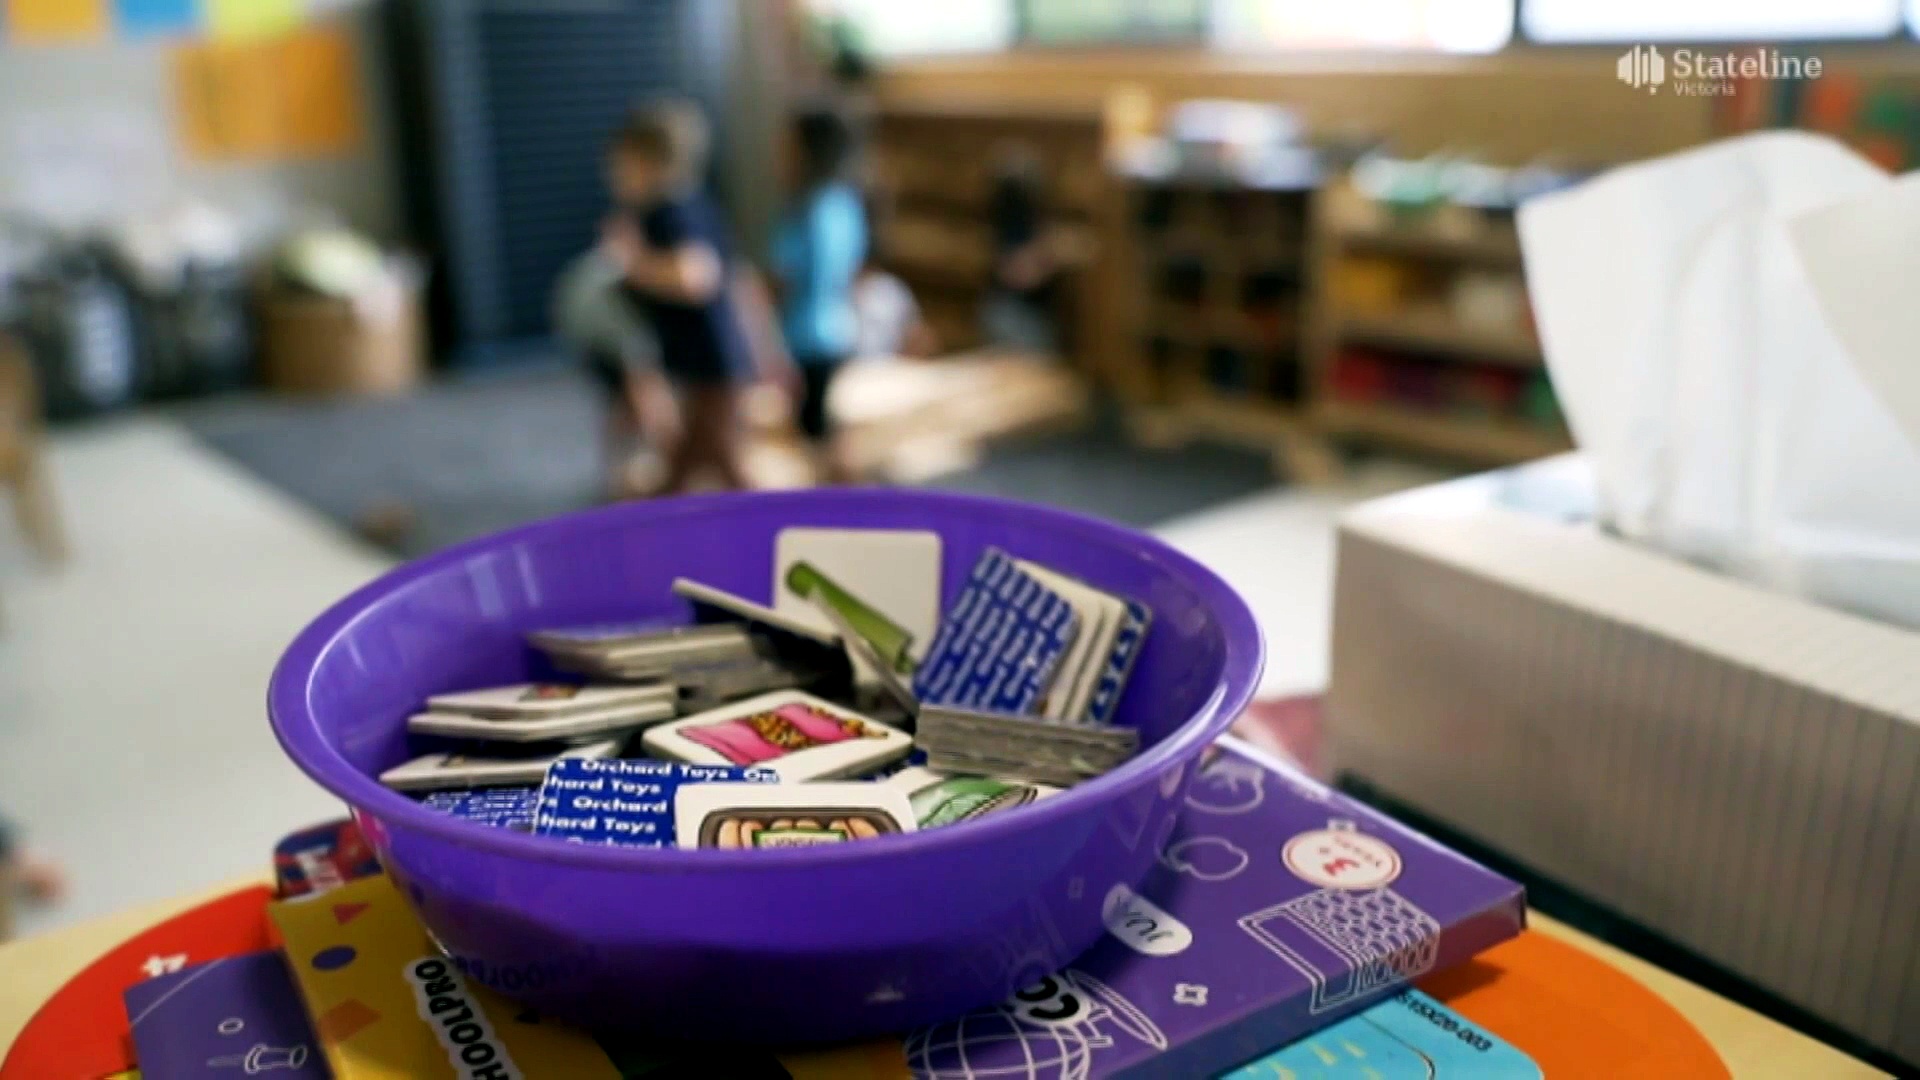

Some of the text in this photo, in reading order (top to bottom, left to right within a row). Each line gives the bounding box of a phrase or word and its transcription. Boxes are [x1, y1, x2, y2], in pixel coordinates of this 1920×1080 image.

[581, 759, 672, 777] Orchard
[680, 765, 728, 782] Toys
[611, 779, 662, 796] Toys
[573, 796, 668, 813] Orchard
[540, 813, 656, 835] hard Toys
